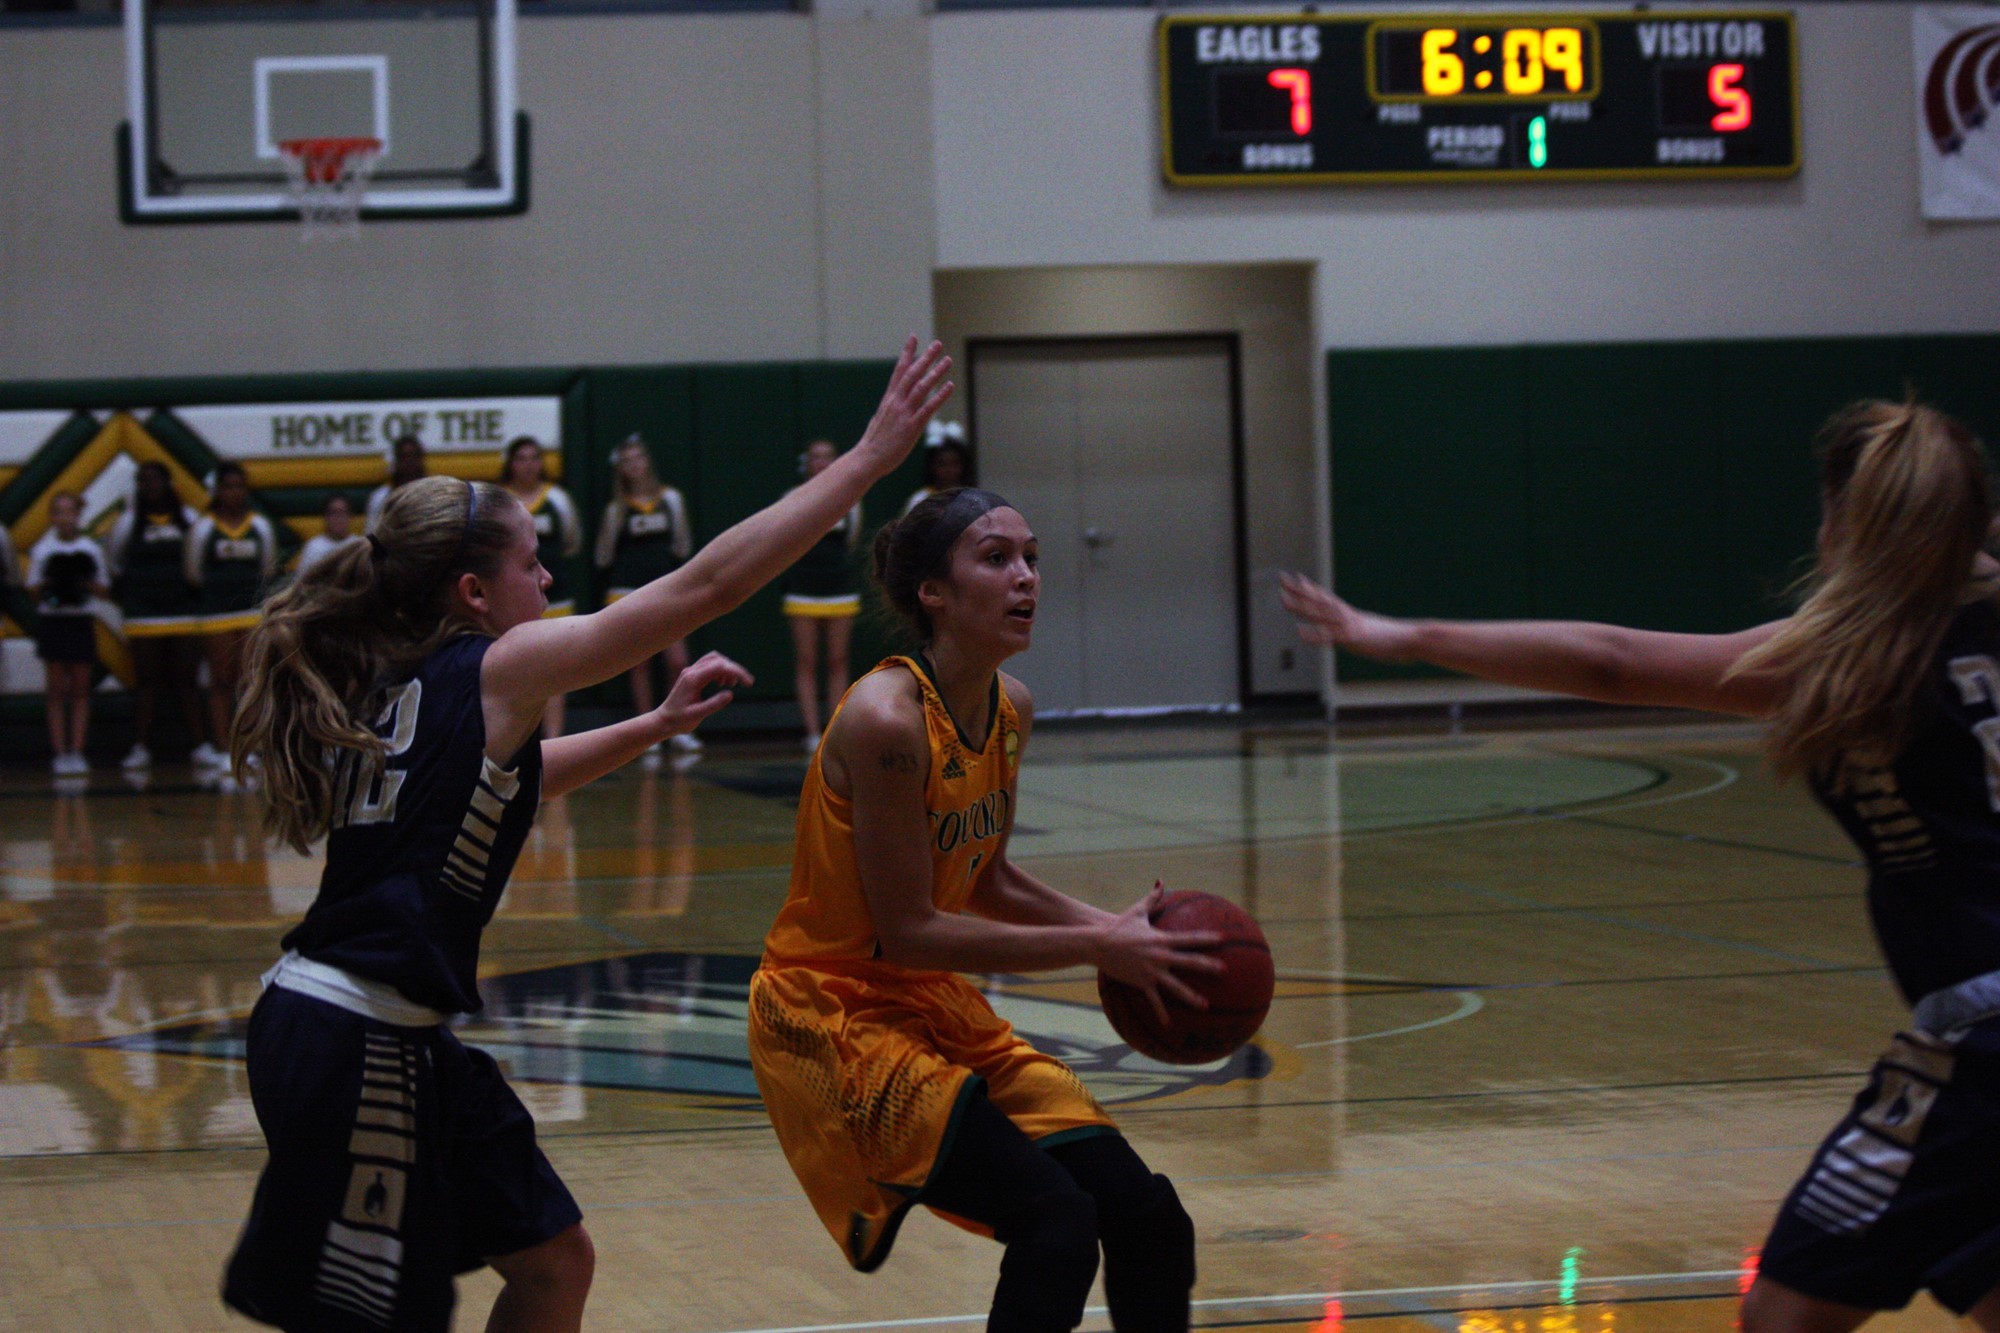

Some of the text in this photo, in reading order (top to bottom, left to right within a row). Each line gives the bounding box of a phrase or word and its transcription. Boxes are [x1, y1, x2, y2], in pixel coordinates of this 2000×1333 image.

[1196, 26, 1321, 62] EAGLES
[1638, 22, 1764, 57] VISITOR
[1420, 28, 1584, 96] 6:09
[1266, 68, 1312, 136] 7
[1706, 62, 1753, 131] 5
[1242, 143, 1313, 167] BONUS
[1428, 125, 1504, 148] PERIOD
[1528, 116, 1547, 168] 1
[1656, 137, 1725, 162] BONUS
[272, 409, 504, 448] HOME OF THE
